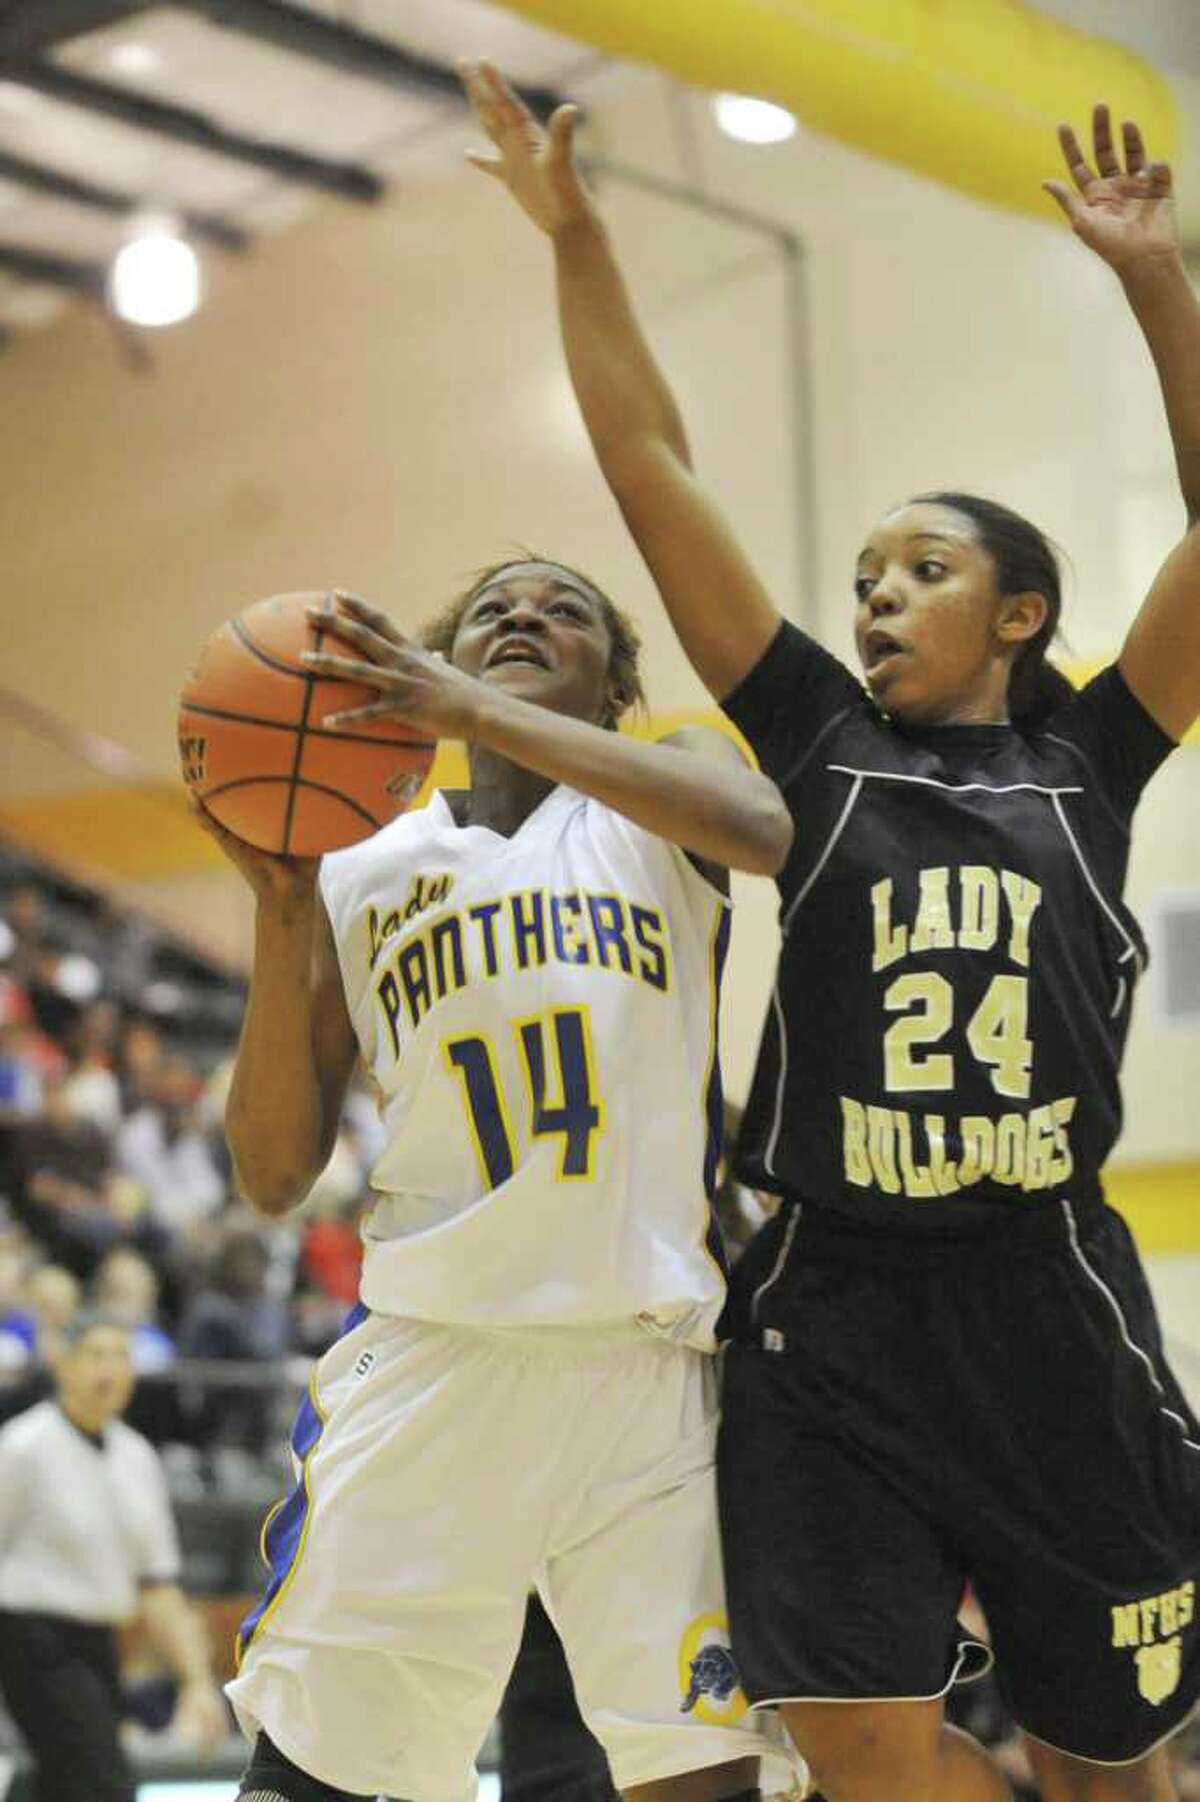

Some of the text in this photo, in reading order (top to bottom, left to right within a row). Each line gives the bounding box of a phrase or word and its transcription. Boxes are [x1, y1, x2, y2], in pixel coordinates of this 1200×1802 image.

[376, 888, 669, 1062] PANTHERS
[871, 865, 1042, 973] LADY
[440, 1004, 606, 1192] 14
[883, 971, 1034, 1099] 24
[839, 1095, 1077, 1198] BULLDOGS
